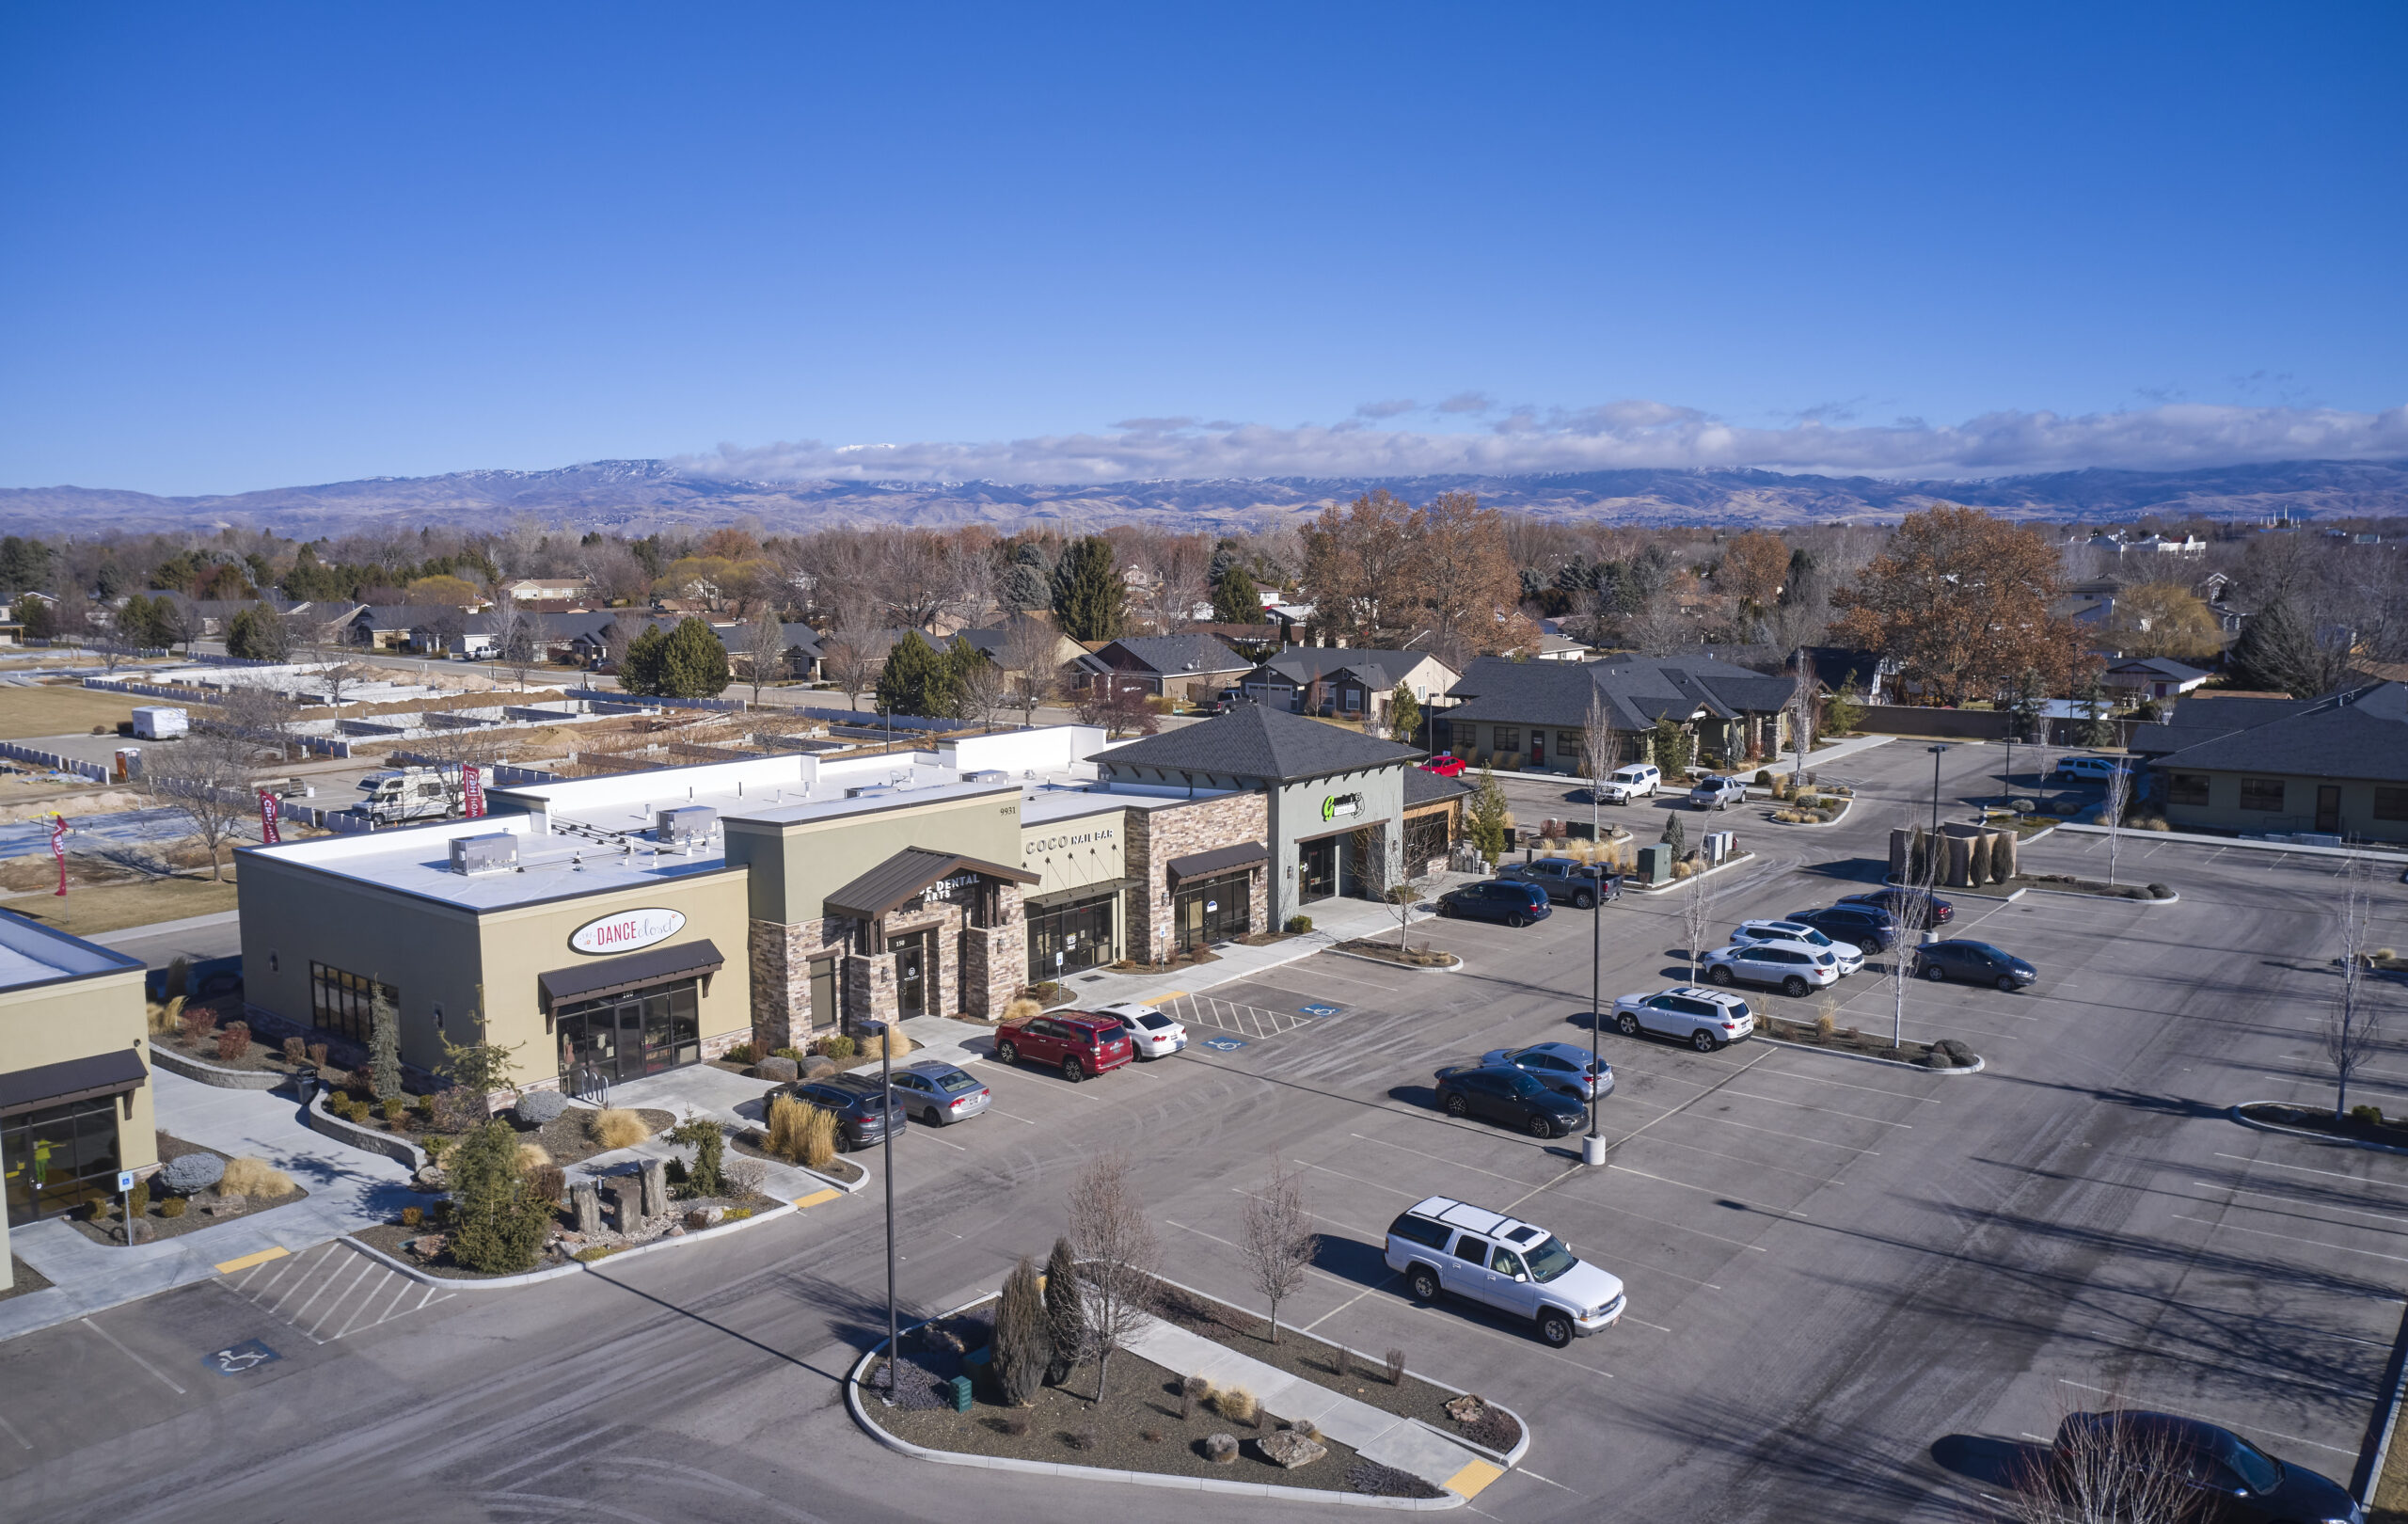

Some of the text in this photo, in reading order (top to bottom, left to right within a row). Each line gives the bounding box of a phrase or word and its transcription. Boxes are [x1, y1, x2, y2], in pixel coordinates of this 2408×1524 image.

[1000, 806, 1016, 817] 9931
[1025, 829, 1115, 855] COCO NAIL BAR
[925, 889, 951, 903] ARTS
[596, 921, 637, 946] DANCE
